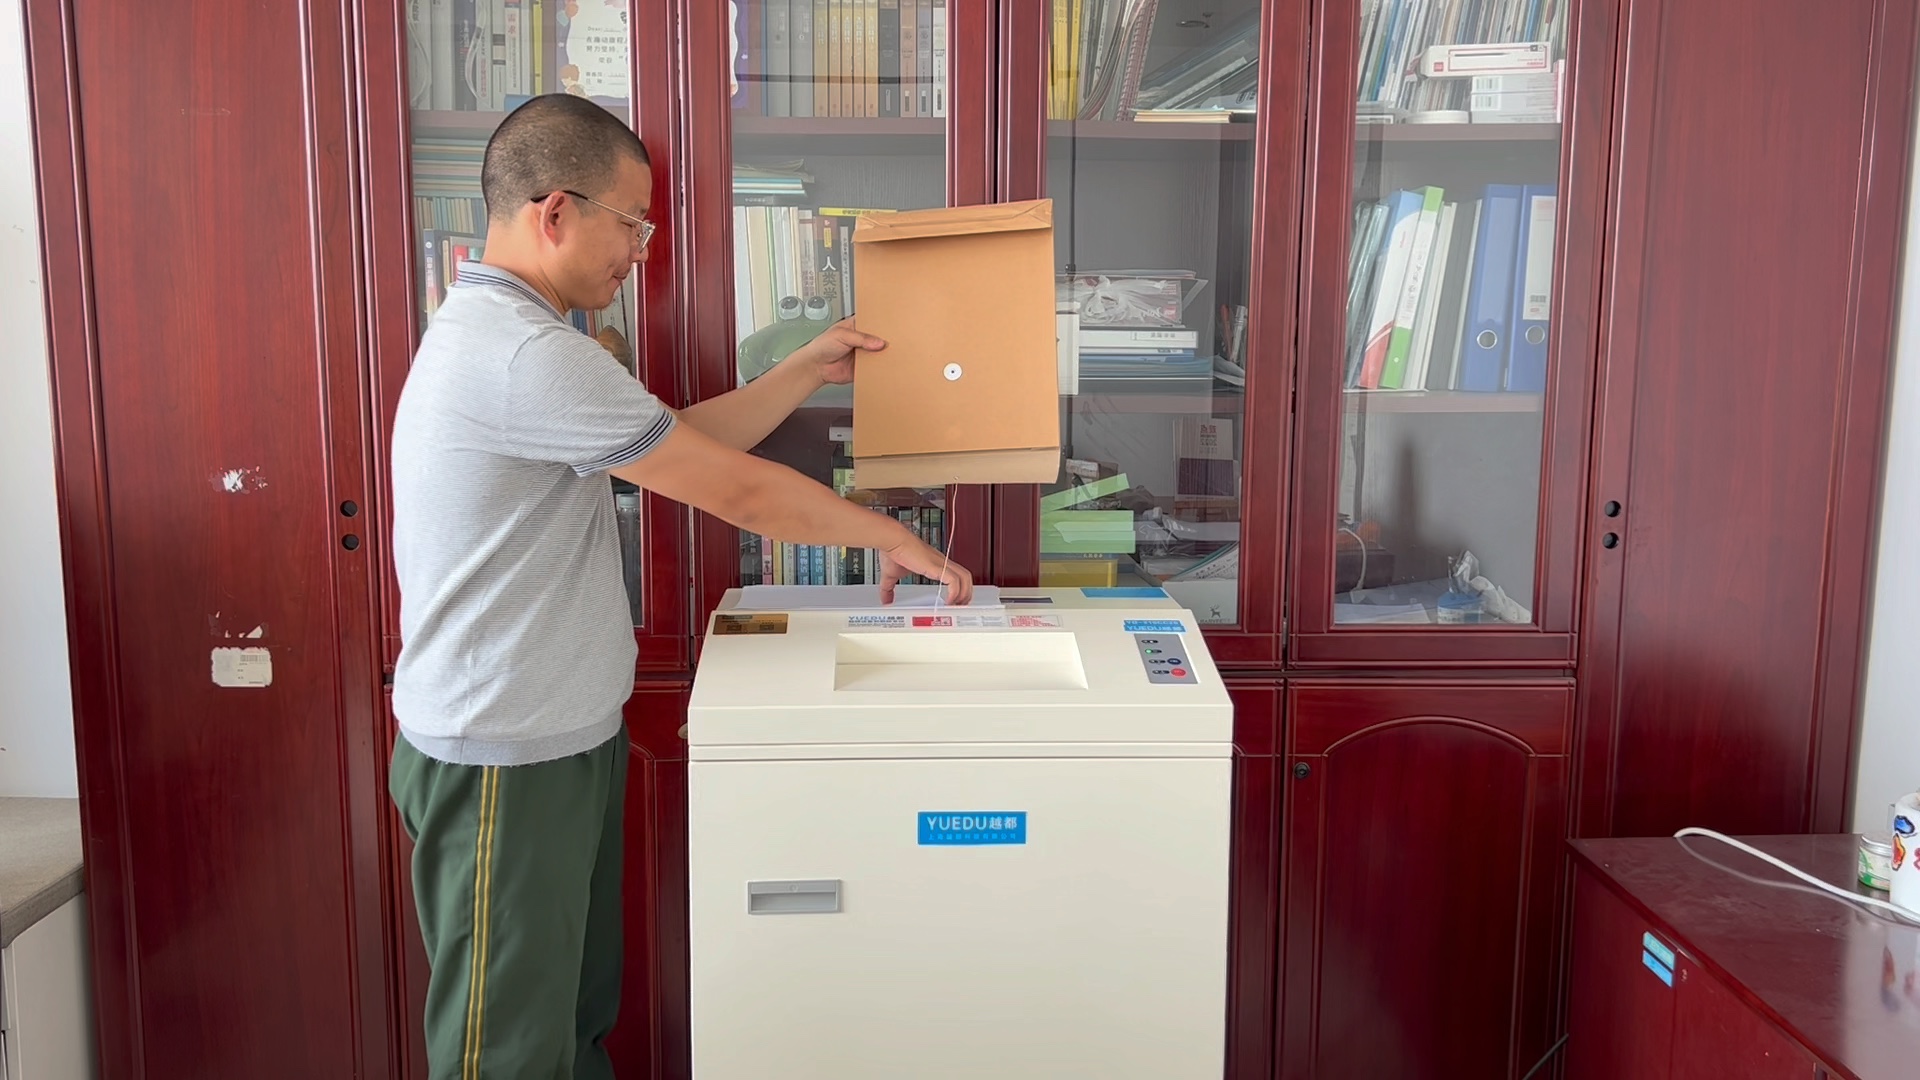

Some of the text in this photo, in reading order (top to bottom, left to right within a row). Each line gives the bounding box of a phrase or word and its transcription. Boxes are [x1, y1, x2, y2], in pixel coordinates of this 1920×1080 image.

[822, 255, 837, 302] 人类学
[926, 816, 1018, 831] YUEDU越都
